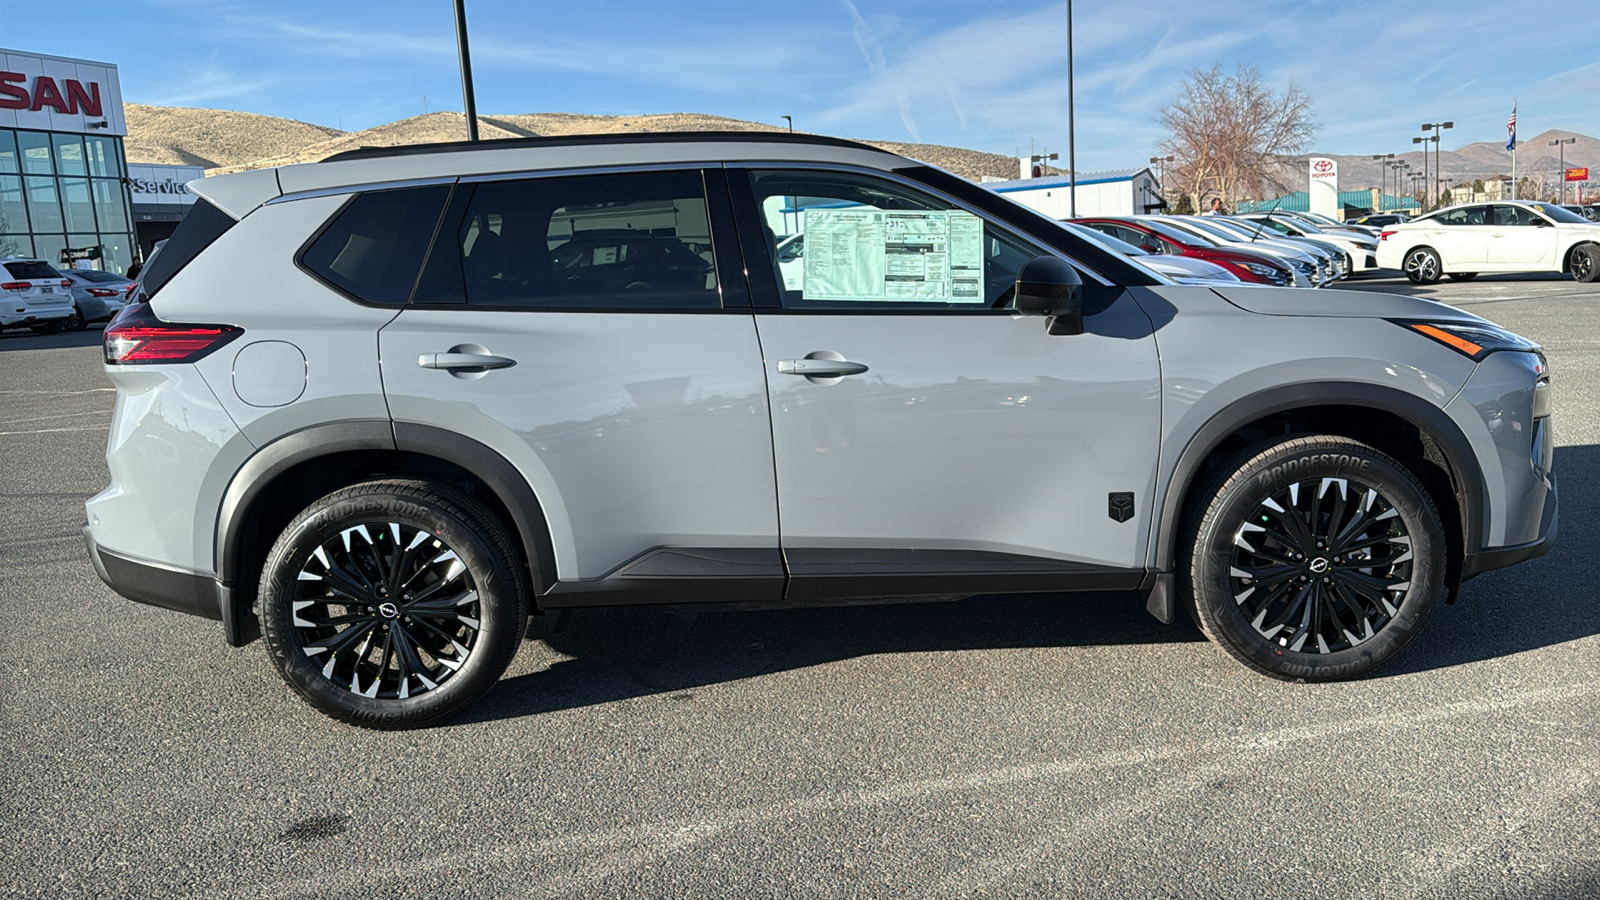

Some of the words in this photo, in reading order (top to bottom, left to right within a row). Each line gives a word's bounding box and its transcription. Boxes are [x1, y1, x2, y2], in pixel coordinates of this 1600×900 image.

[889, 220, 899, 228] 31
[1258, 454, 1370, 487] BRIDGESTONE
[314, 500, 428, 526] BRIDGESTONE
